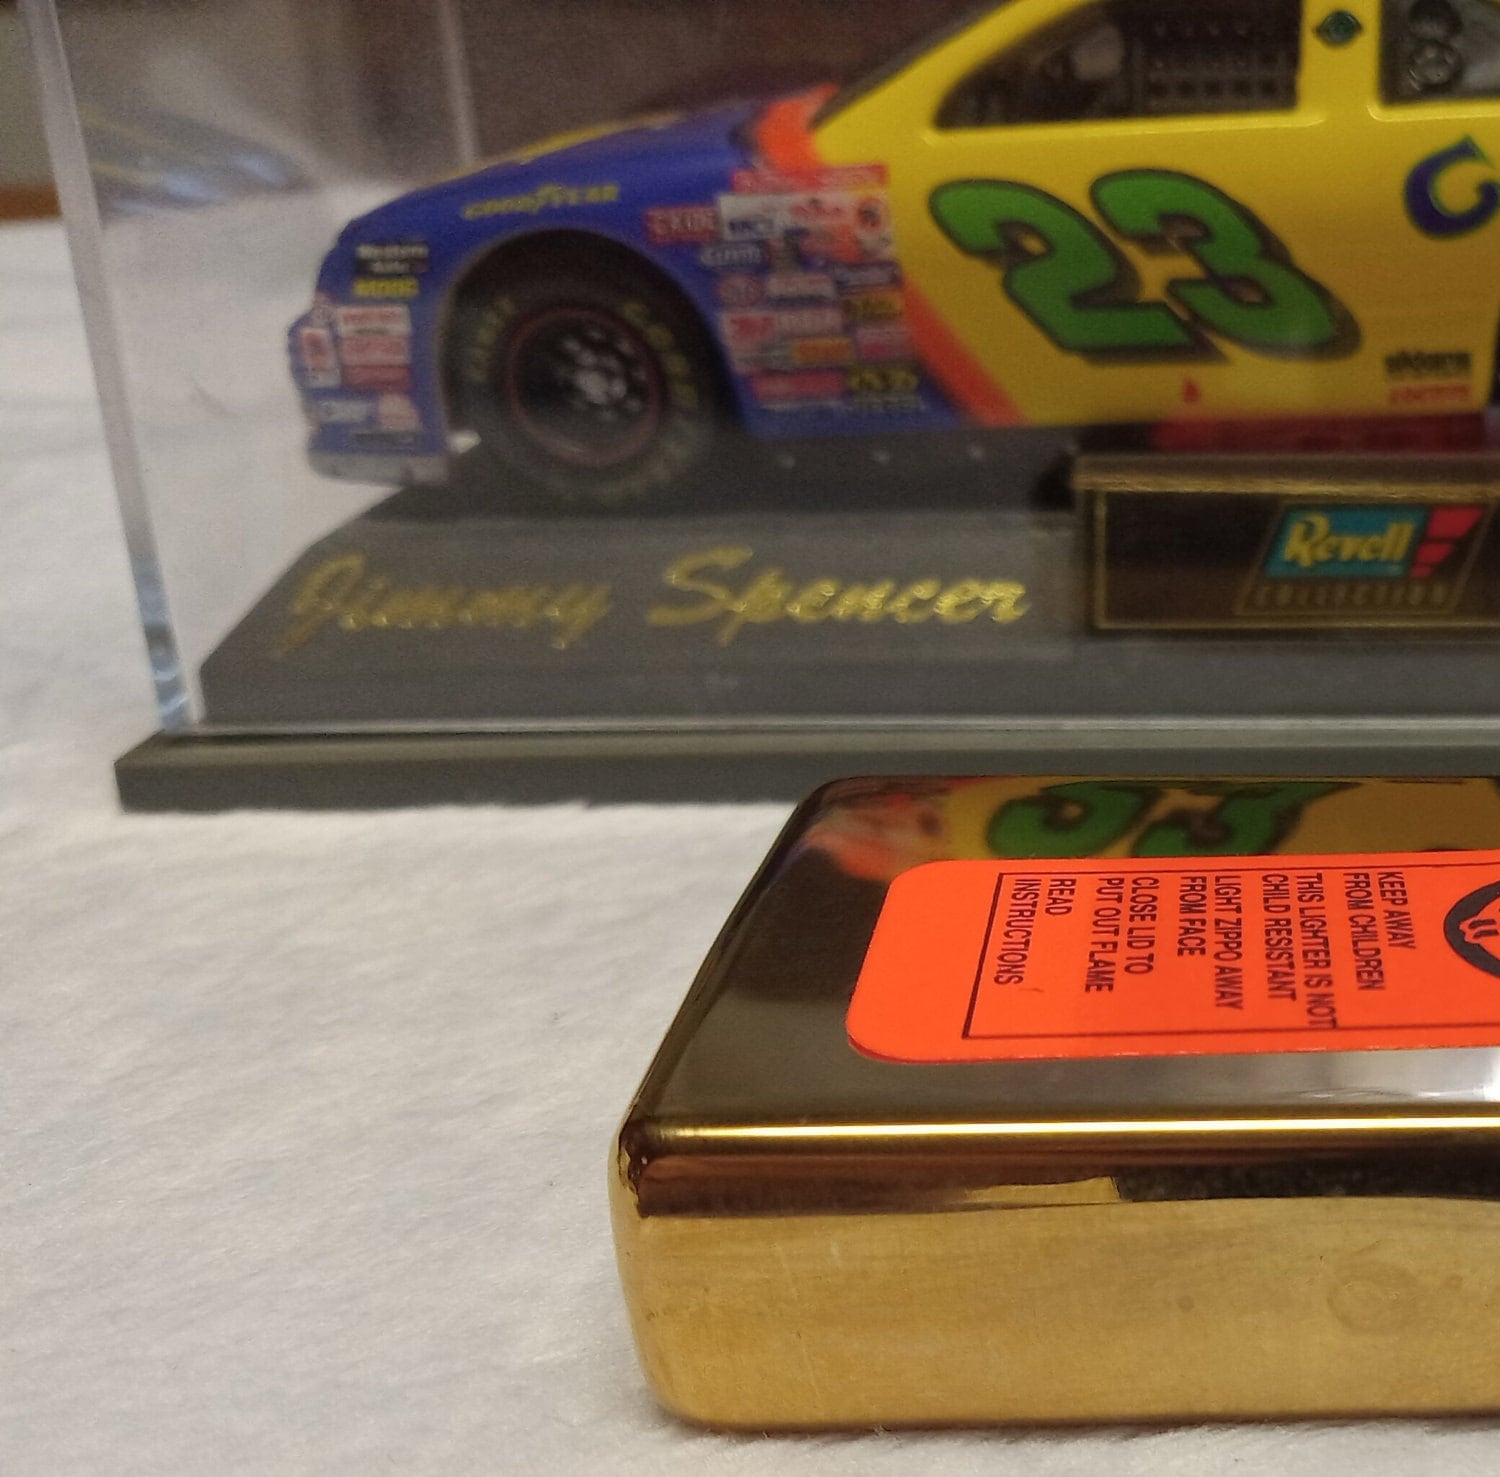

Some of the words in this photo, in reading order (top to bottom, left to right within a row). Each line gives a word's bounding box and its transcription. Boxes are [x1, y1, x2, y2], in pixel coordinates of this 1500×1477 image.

[928, 166, 1362, 366] 23
[1281, 511, 1416, 568] Revell
[270, 552, 611, 658] Jimmy
[646, 546, 1028, 647] Spencer
[1045, 878, 1077, 916] READ
[1096, 877, 1125, 903] PUT
[1128, 876, 1159, 923] CLOSE
[1178, 876, 1207, 914] FROM
[1214, 875, 1242, 914] LIGHT
[1261, 873, 1291, 914] CHILD
[1296, 872, 1325, 903] THIS
[1343, 872, 1375, 910] FROM
[1377, 871, 1408, 906] KEEP
[994, 878, 1042, 986] INSTRUCTIONS
[1091, 907, 1122, 937] OUT
[1126, 926, 1156, 950] LID
[1176, 918, 1207, 957] FACE
[1213, 917, 1243, 962] ZIPPO
[1299, 906, 1331, 969] LIGHTER
[1383, 909, 1416, 950] AWAY
[1084, 941, 1118, 993] FLAME
[1124, 953, 1155, 975] TO
[1264, 918, 1297, 1001] RESISTANT
[1347, 914, 1386, 991] CHILDREN
[1214, 964, 1244, 1011] AWAY
[1303, 974, 1334, 989] IS
[1306, 992, 1339, 1029] NOT
